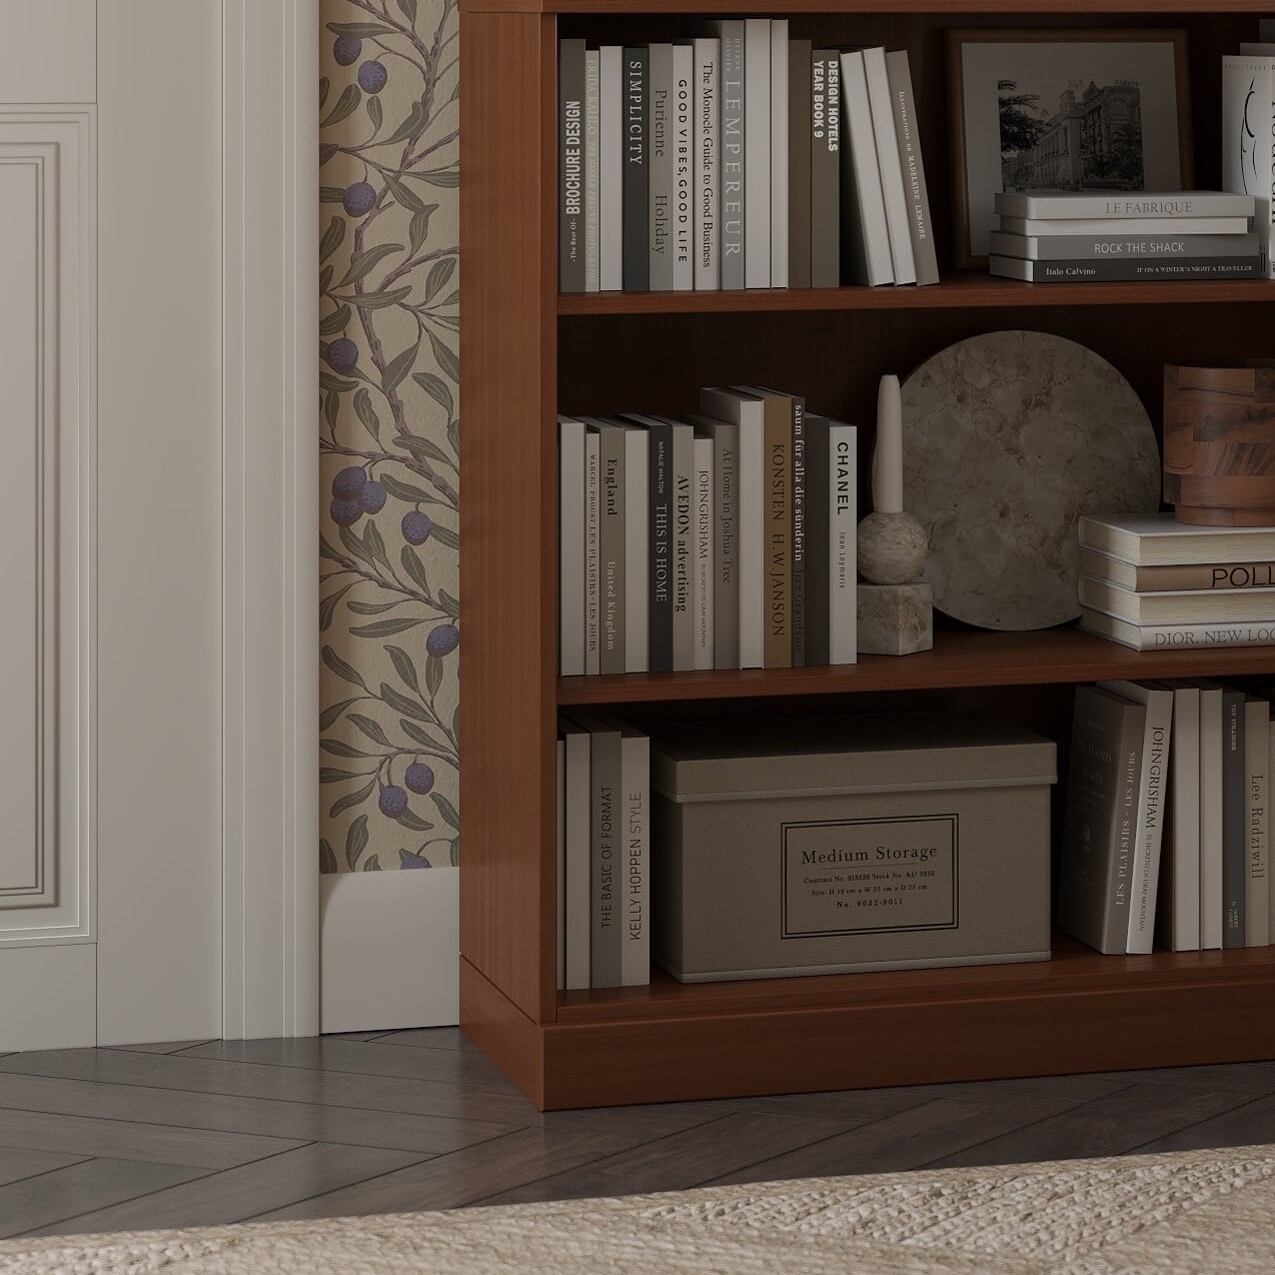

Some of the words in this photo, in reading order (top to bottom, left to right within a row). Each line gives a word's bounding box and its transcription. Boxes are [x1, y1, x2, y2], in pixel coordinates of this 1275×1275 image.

[703, 62, 712, 83] The
[814, 61, 824, 90] YEAR
[828, 61, 838, 104] DESIGN
[630, 62, 642, 164] SIMPLICITY
[679, 80, 687, 122] GOOD
[703, 88, 712, 134] Monocle
[814, 95, 824, 127] BOOK
[566, 101, 580, 145] DESIGN
[656, 90, 667, 156] Purienne
[828, 108, 838, 152] HOTELS
[703, 138, 712, 170] Guide
[566, 148, 580, 214] BROCHURE
[703, 175, 712, 184] to
[703, 188, 713, 217] Good
[1106, 203, 1121, 213] LE
[1126, 201, 1192, 213] FABRIQUE
[652, 195, 668, 254] Holiday
[679, 231, 687, 261] LIFE
[703, 222, 713, 267] Business
[1095, 244, 1122, 253] ROCK
[1128, 243, 1146, 253] THE
[1150, 242, 1184, 252] SHACK
[1066, 267, 1095, 275] Calvino
[723, 449, 732, 462] At
[795, 461, 804, 482] alla
[605, 460, 617, 516] England
[723, 467, 732, 498] Home
[772, 445, 784, 520] KONSTEN
[795, 487, 804, 505] die
[838, 442, 848, 515] CHANEL
[656, 504, 667, 537] THIS
[678, 476, 689, 535] AVEDON
[723, 503, 732, 513] in
[656, 541, 667, 553] IS
[721, 516, 732, 555] Joshua
[656, 558, 667, 602] HOME
[675, 540, 689, 612] advertising
[723, 559, 732, 583] Tree
[838, 553, 846, 589] Leymarie
[605, 602, 615, 650] Kingdom
[1204, 630, 1242, 643] NEW
[1252, 775, 1263, 800] Lee
[601, 787, 612, 838] FORMAT
[630, 793, 641, 834] STYLE
[601, 843, 611, 859] OF
[802, 850, 868, 864] Medium
[876, 847, 937, 861] Storage
[1118, 821, 1130, 877] PLAISIRS
[1251, 808, 1263, 879] Radziwill
[601, 865, 611, 900] BASIC
[630, 840, 641, 893] HOPPEN
[601, 906, 611, 928] THE
[630, 899, 641, 940] KELLY
